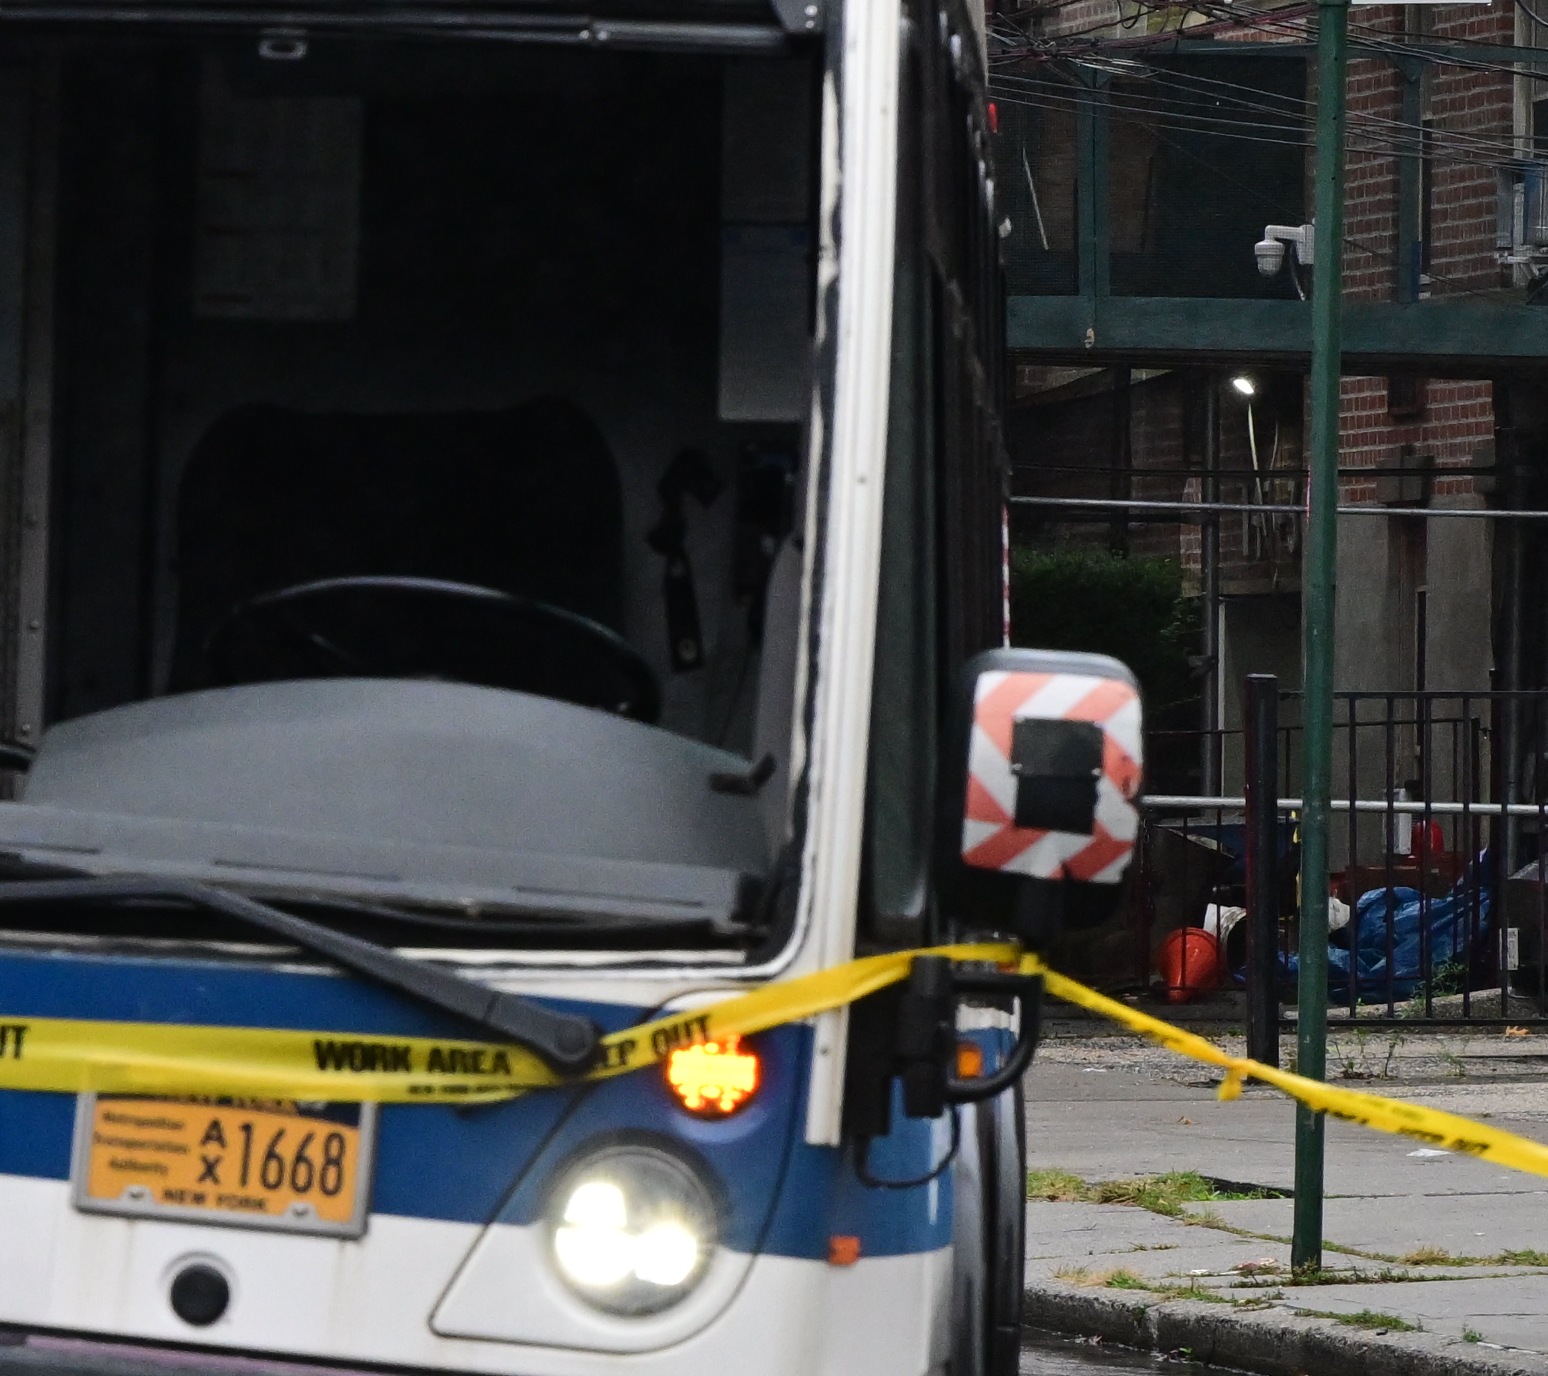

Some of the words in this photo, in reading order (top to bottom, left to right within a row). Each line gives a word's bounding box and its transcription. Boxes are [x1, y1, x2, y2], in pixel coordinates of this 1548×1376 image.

[651, 1014, 712, 1057] OUT
[313, 1039, 412, 1074] WORK
[426, 1045, 512, 1077] AREA
[238, 1122, 347, 1197] 1668
[163, 1188, 207, 1205] NEW
[216, 1192, 267, 1210] YORK
